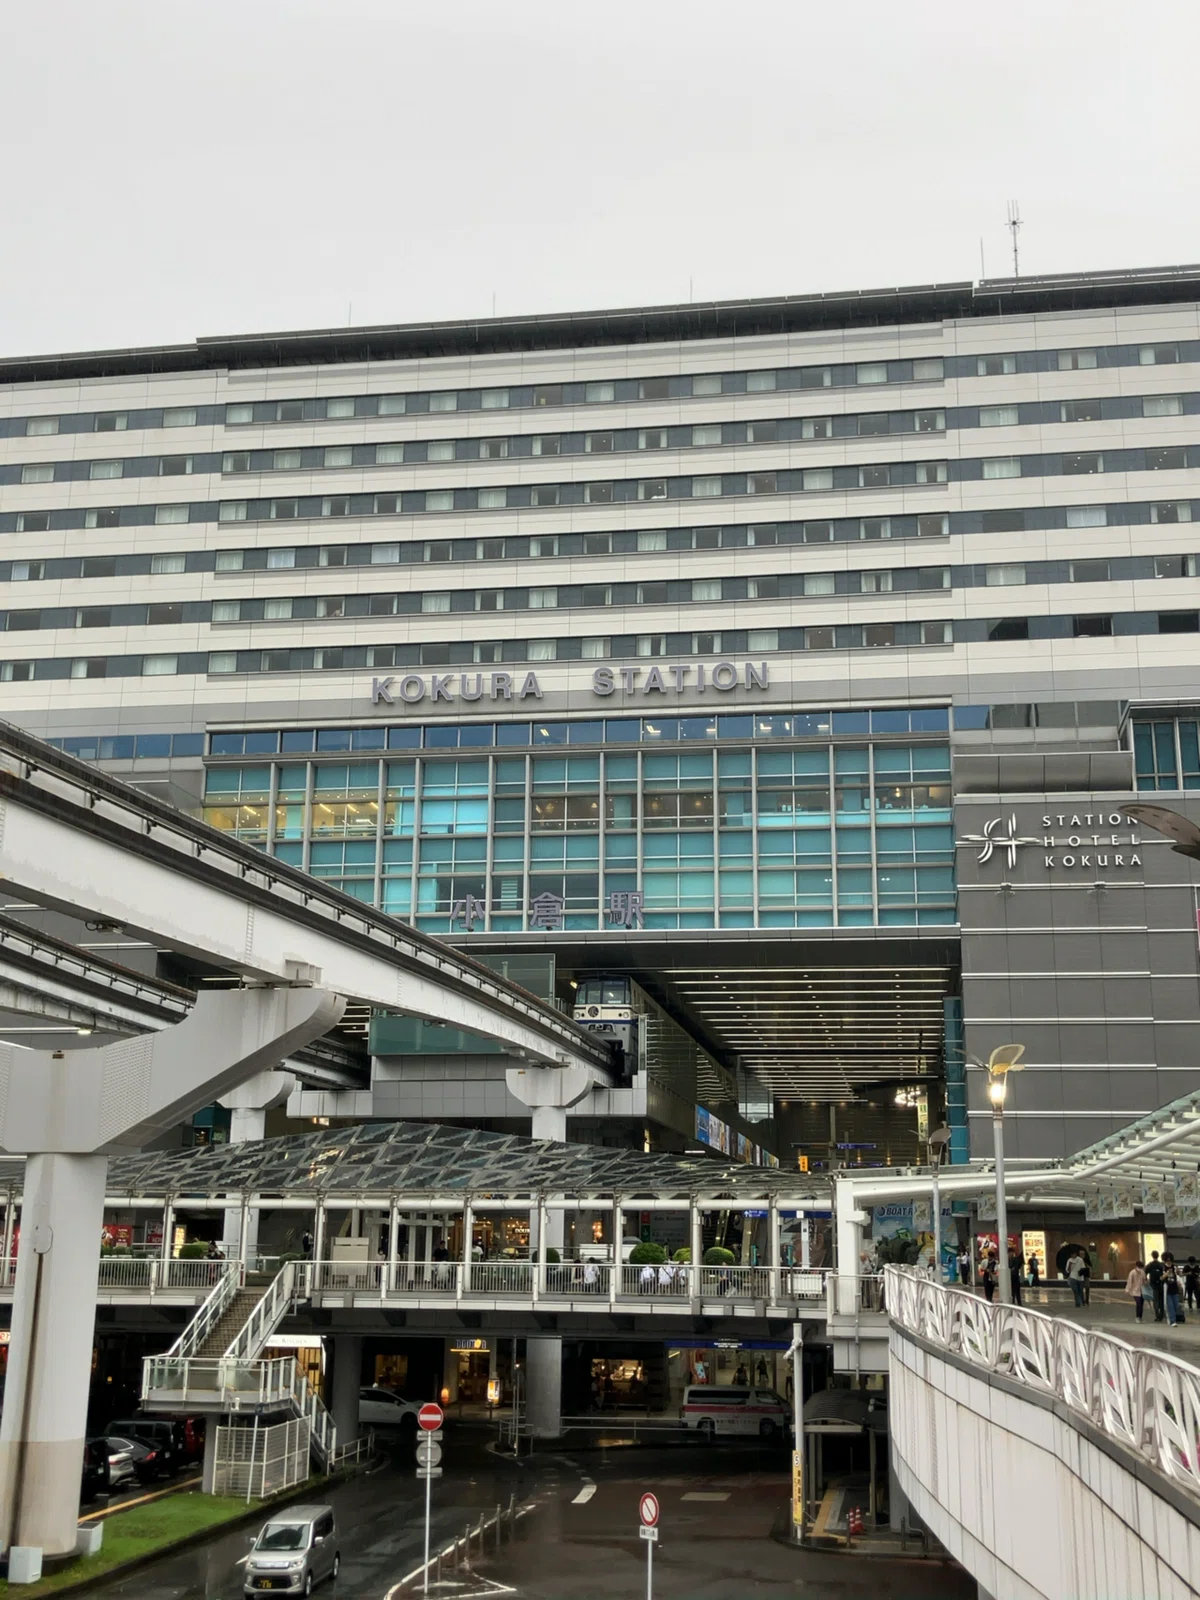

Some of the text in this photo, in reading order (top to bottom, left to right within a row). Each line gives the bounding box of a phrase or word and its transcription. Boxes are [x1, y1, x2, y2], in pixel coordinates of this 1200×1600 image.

[371, 661, 770, 703] KOKURA STATION
[1042, 814, 1138, 827] STATION
[1044, 834, 1139, 847] HOTEL
[1045, 855, 1142, 867] KOKURA
[450, 892, 645, 930] 小倉駅
[886, 1207, 906, 1217] BOAT
